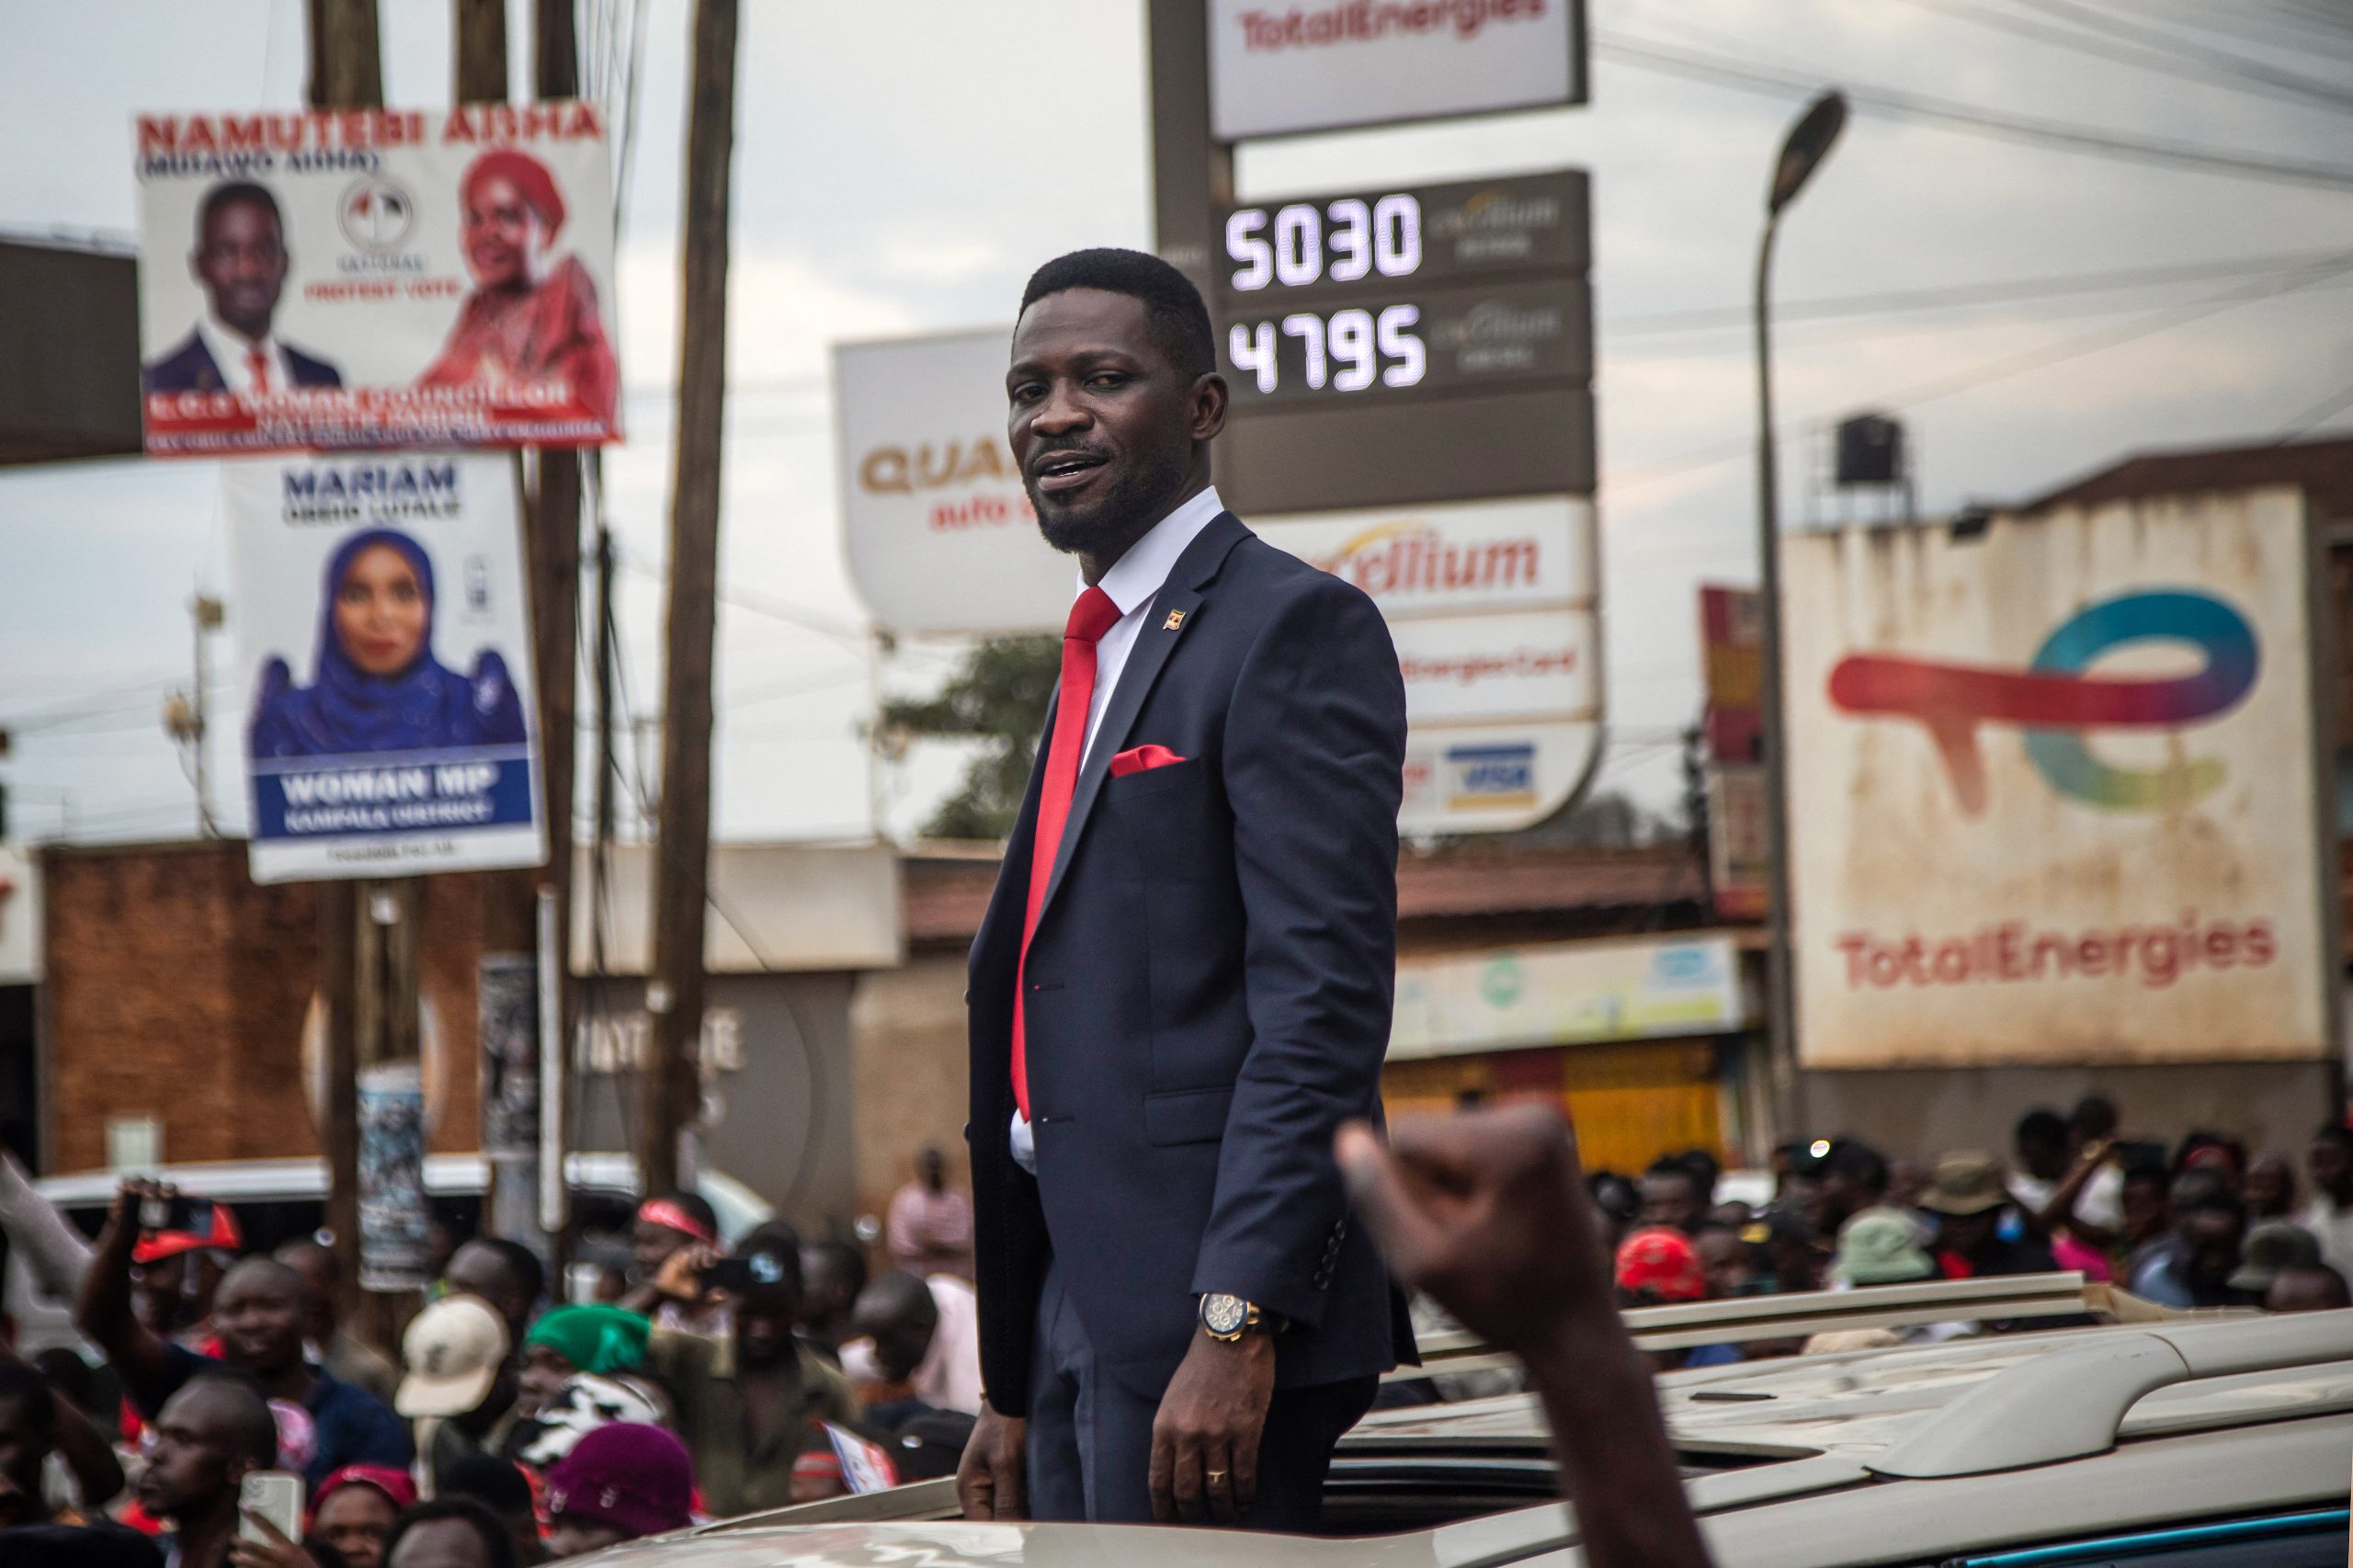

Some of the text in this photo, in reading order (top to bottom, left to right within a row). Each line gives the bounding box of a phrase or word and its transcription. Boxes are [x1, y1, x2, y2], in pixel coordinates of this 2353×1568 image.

[1235, 0, 1547, 53] TotalEnergies
[138, 100, 605, 155] NAMUTEBI AISHA
[1225, 194, 1423, 291] 5030
[1229, 303, 1427, 394] 4795
[283, 461, 456, 500] MARIAM
[859, 435, 1020, 497] QUA
[930, 495, 1010, 532] auto
[279, 761, 500, 807] WOMAN MP
[1836, 909, 2278, 992] TotalEnergies
